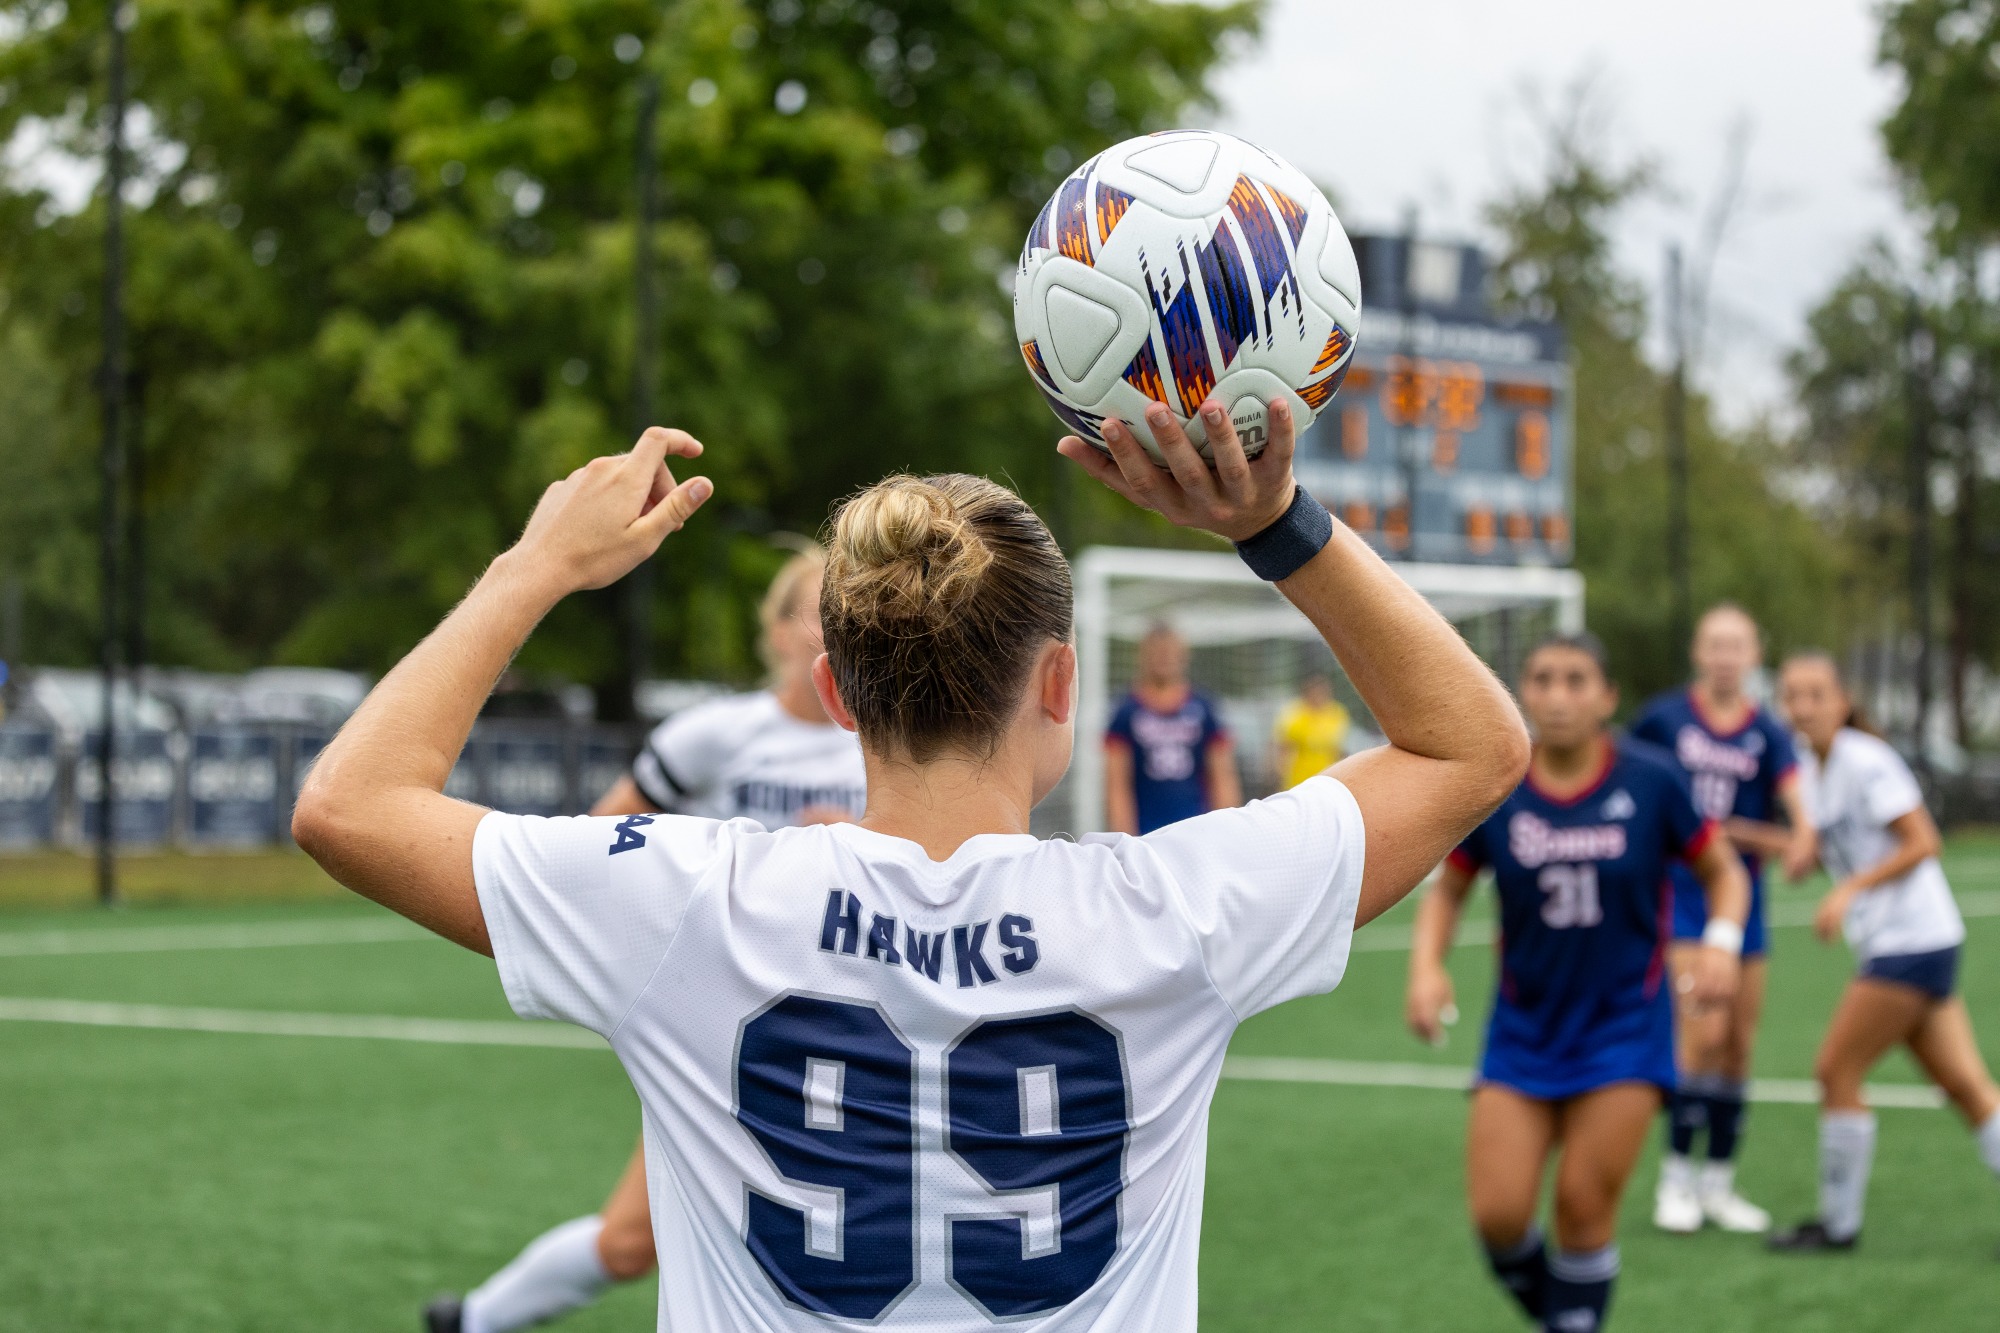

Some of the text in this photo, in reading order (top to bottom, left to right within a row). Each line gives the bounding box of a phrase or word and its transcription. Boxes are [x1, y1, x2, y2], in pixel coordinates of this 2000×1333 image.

[1233, 411, 1261, 426] VIVIDO
[609, 813, 657, 856] AA
[1539, 865, 1602, 928] 31
[817, 888, 1041, 989] HAWKS
[730, 987, 1136, 1325] 99
